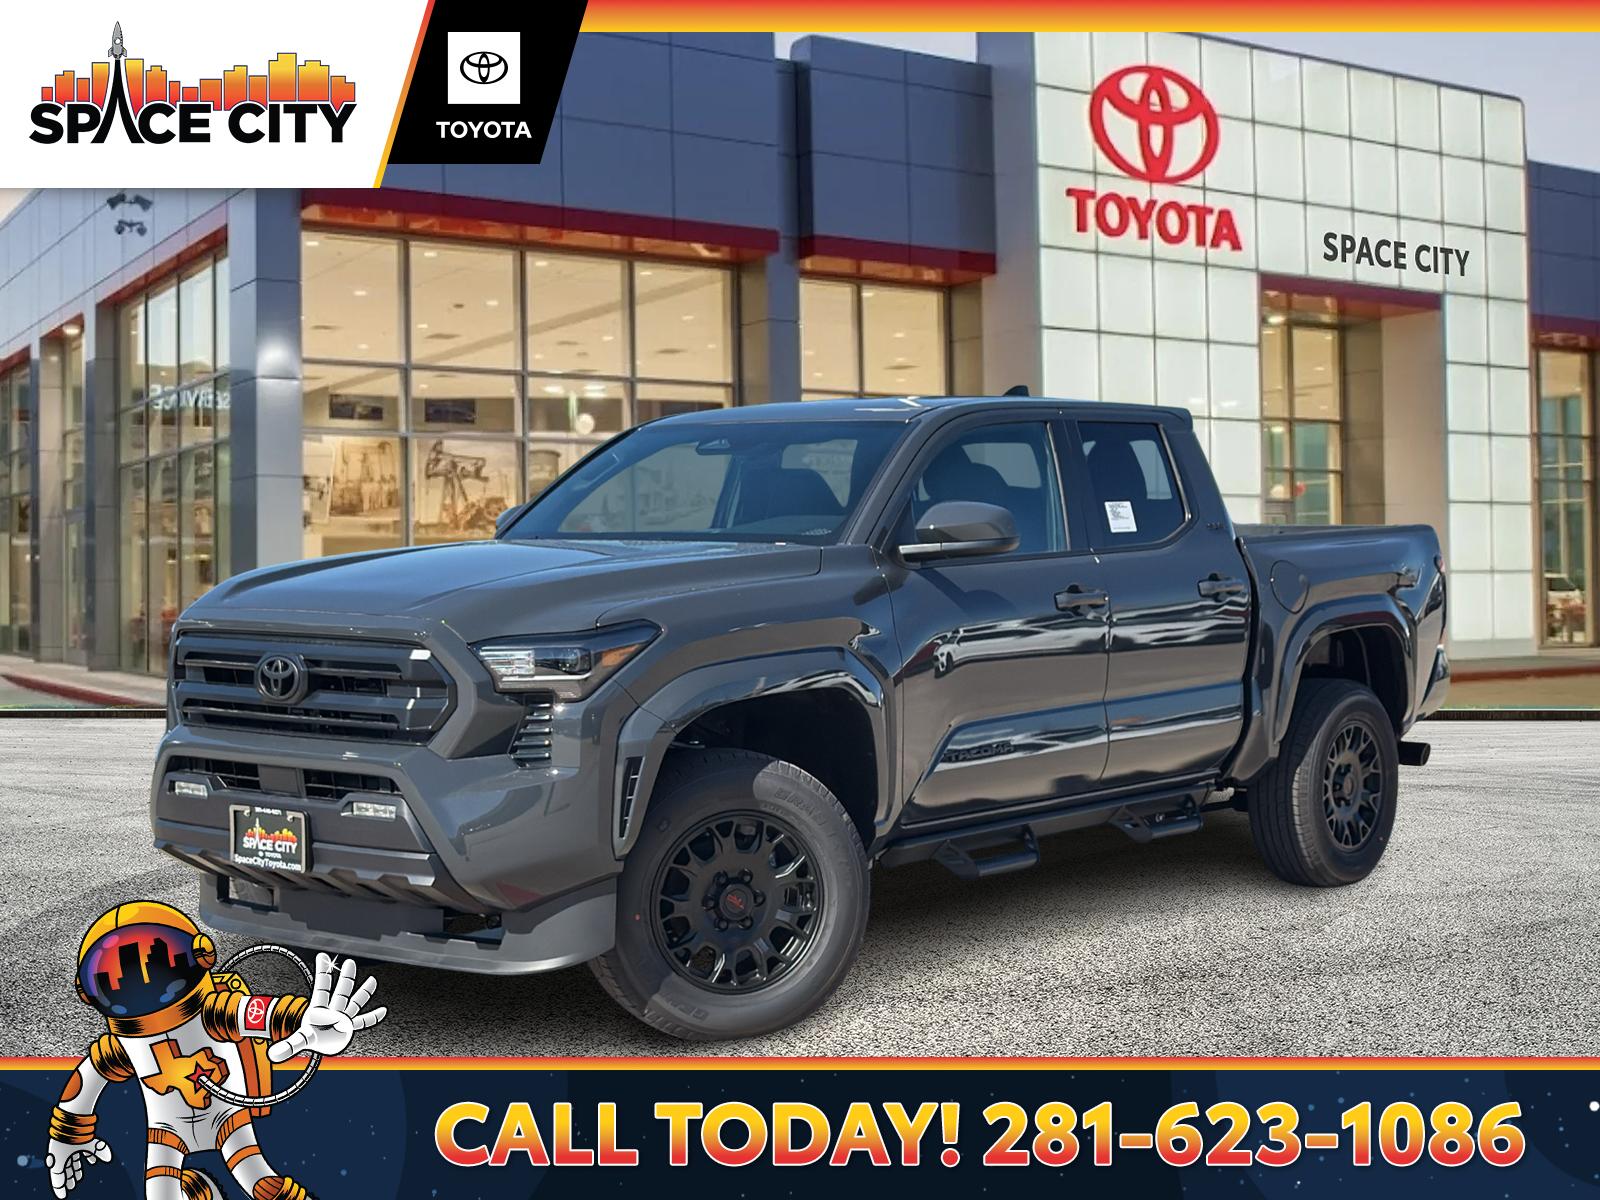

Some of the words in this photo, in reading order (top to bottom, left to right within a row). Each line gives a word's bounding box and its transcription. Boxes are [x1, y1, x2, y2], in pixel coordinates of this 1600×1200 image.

[1066, 188, 1242, 251] TOYOTA
[1323, 231, 1406, 270] SPACE
[1415, 244, 1470, 276] CITY
[243, 834, 273, 851] SPACE
[274, 840, 297, 854] CITY
